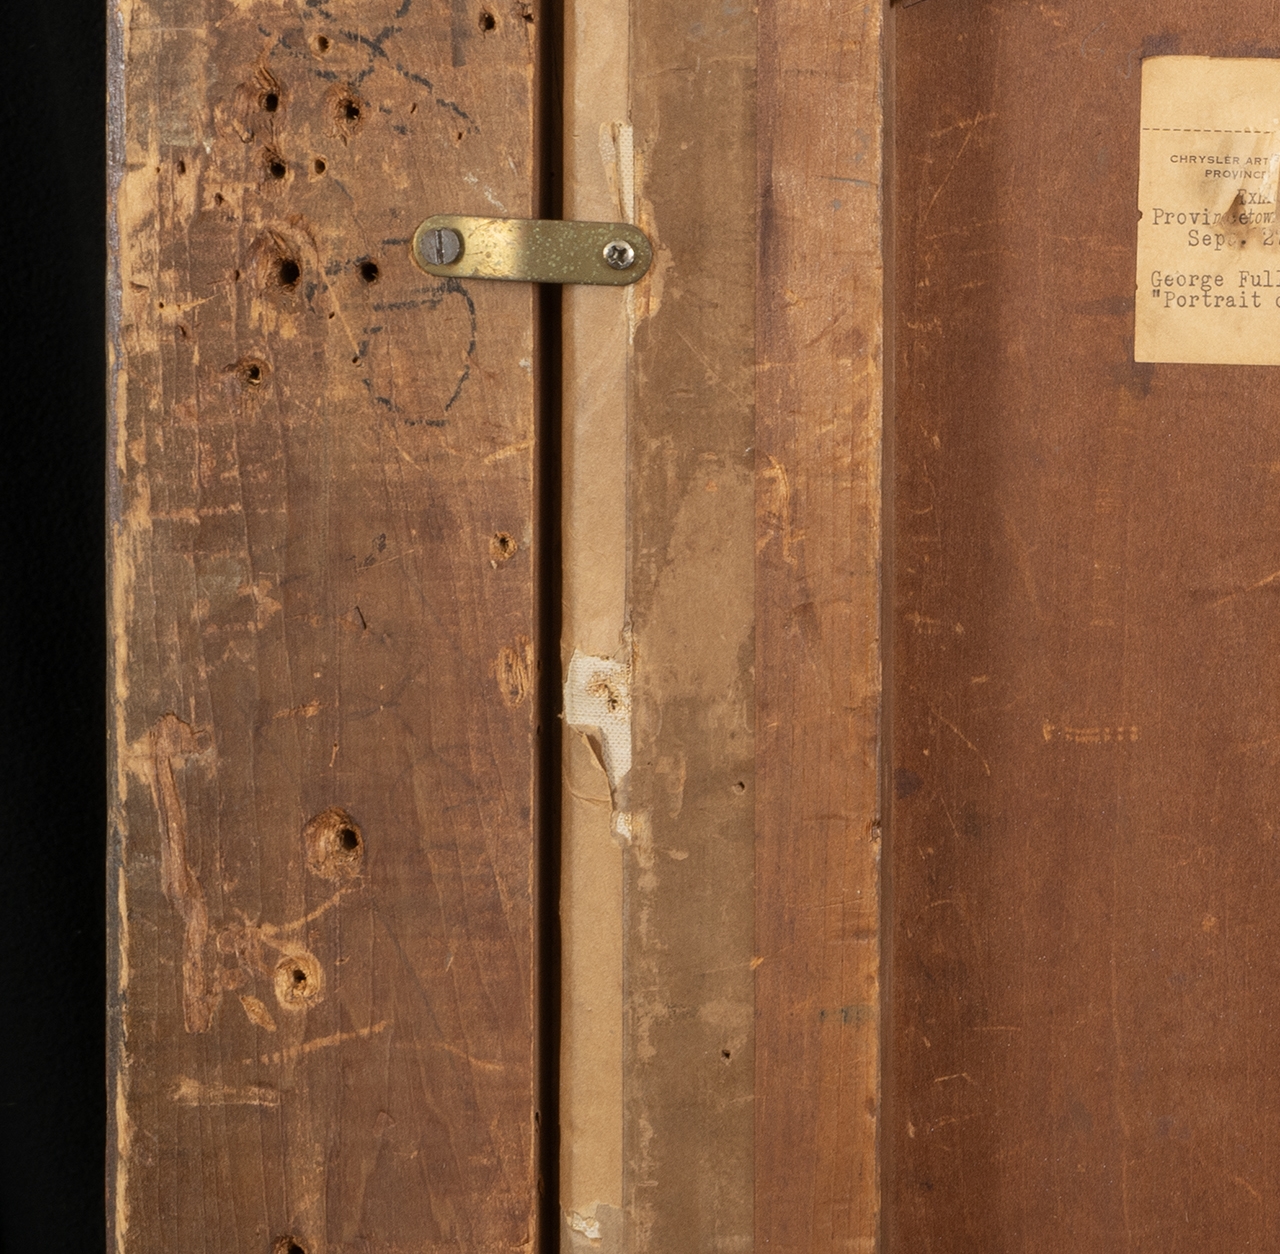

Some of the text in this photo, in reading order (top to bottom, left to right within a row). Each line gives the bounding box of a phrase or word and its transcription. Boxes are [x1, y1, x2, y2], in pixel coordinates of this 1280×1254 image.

[1169, 154, 1240, 165] CHRYSLER
[1151, 270, 1225, 292] George
[1151, 288, 1262, 309] "Portrait
